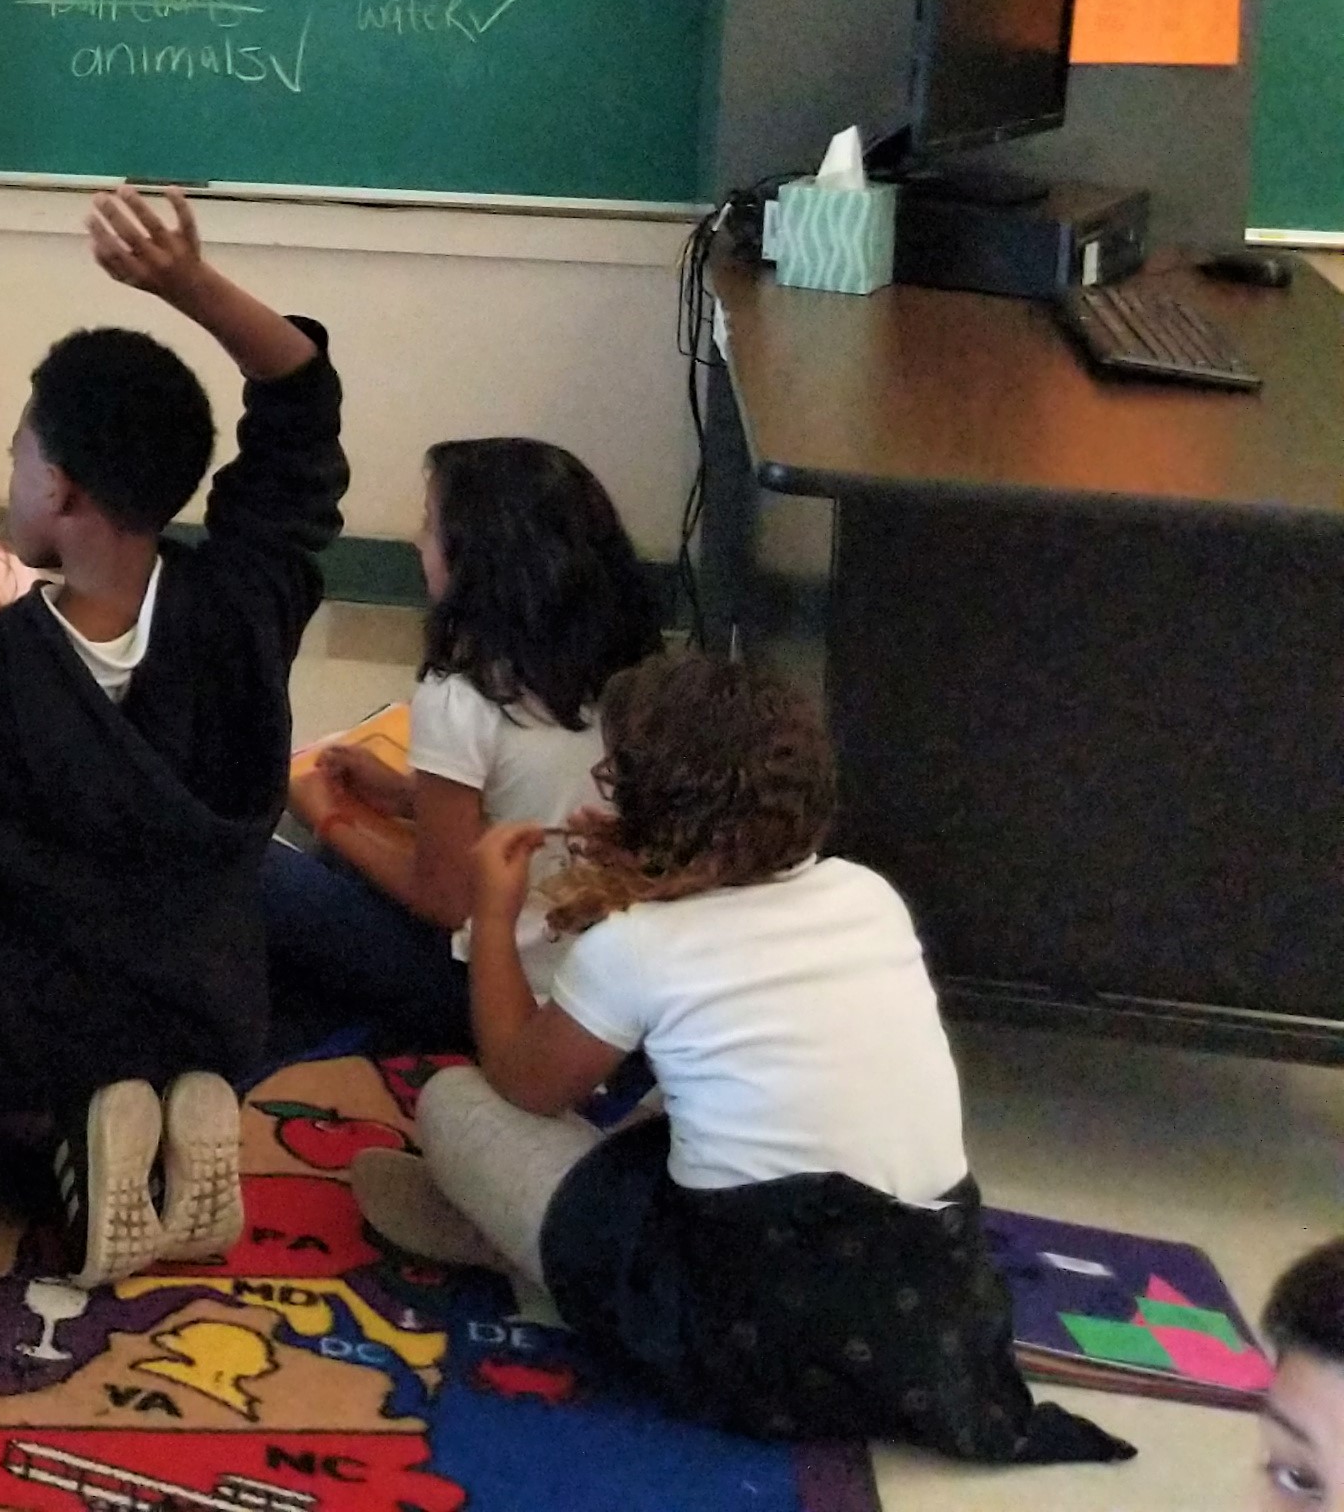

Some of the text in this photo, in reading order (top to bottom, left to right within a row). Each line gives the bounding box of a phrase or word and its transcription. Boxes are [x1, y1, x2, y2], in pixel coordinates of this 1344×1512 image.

[71, 34, 269, 83] animals
[251, 1227, 329, 1255] PA
[232, 1279, 320, 1307] MD
[319, 1337, 386, 1364] DC
[102, 1383, 184, 1418] VA
[266, 1445, 371, 1483] NC
